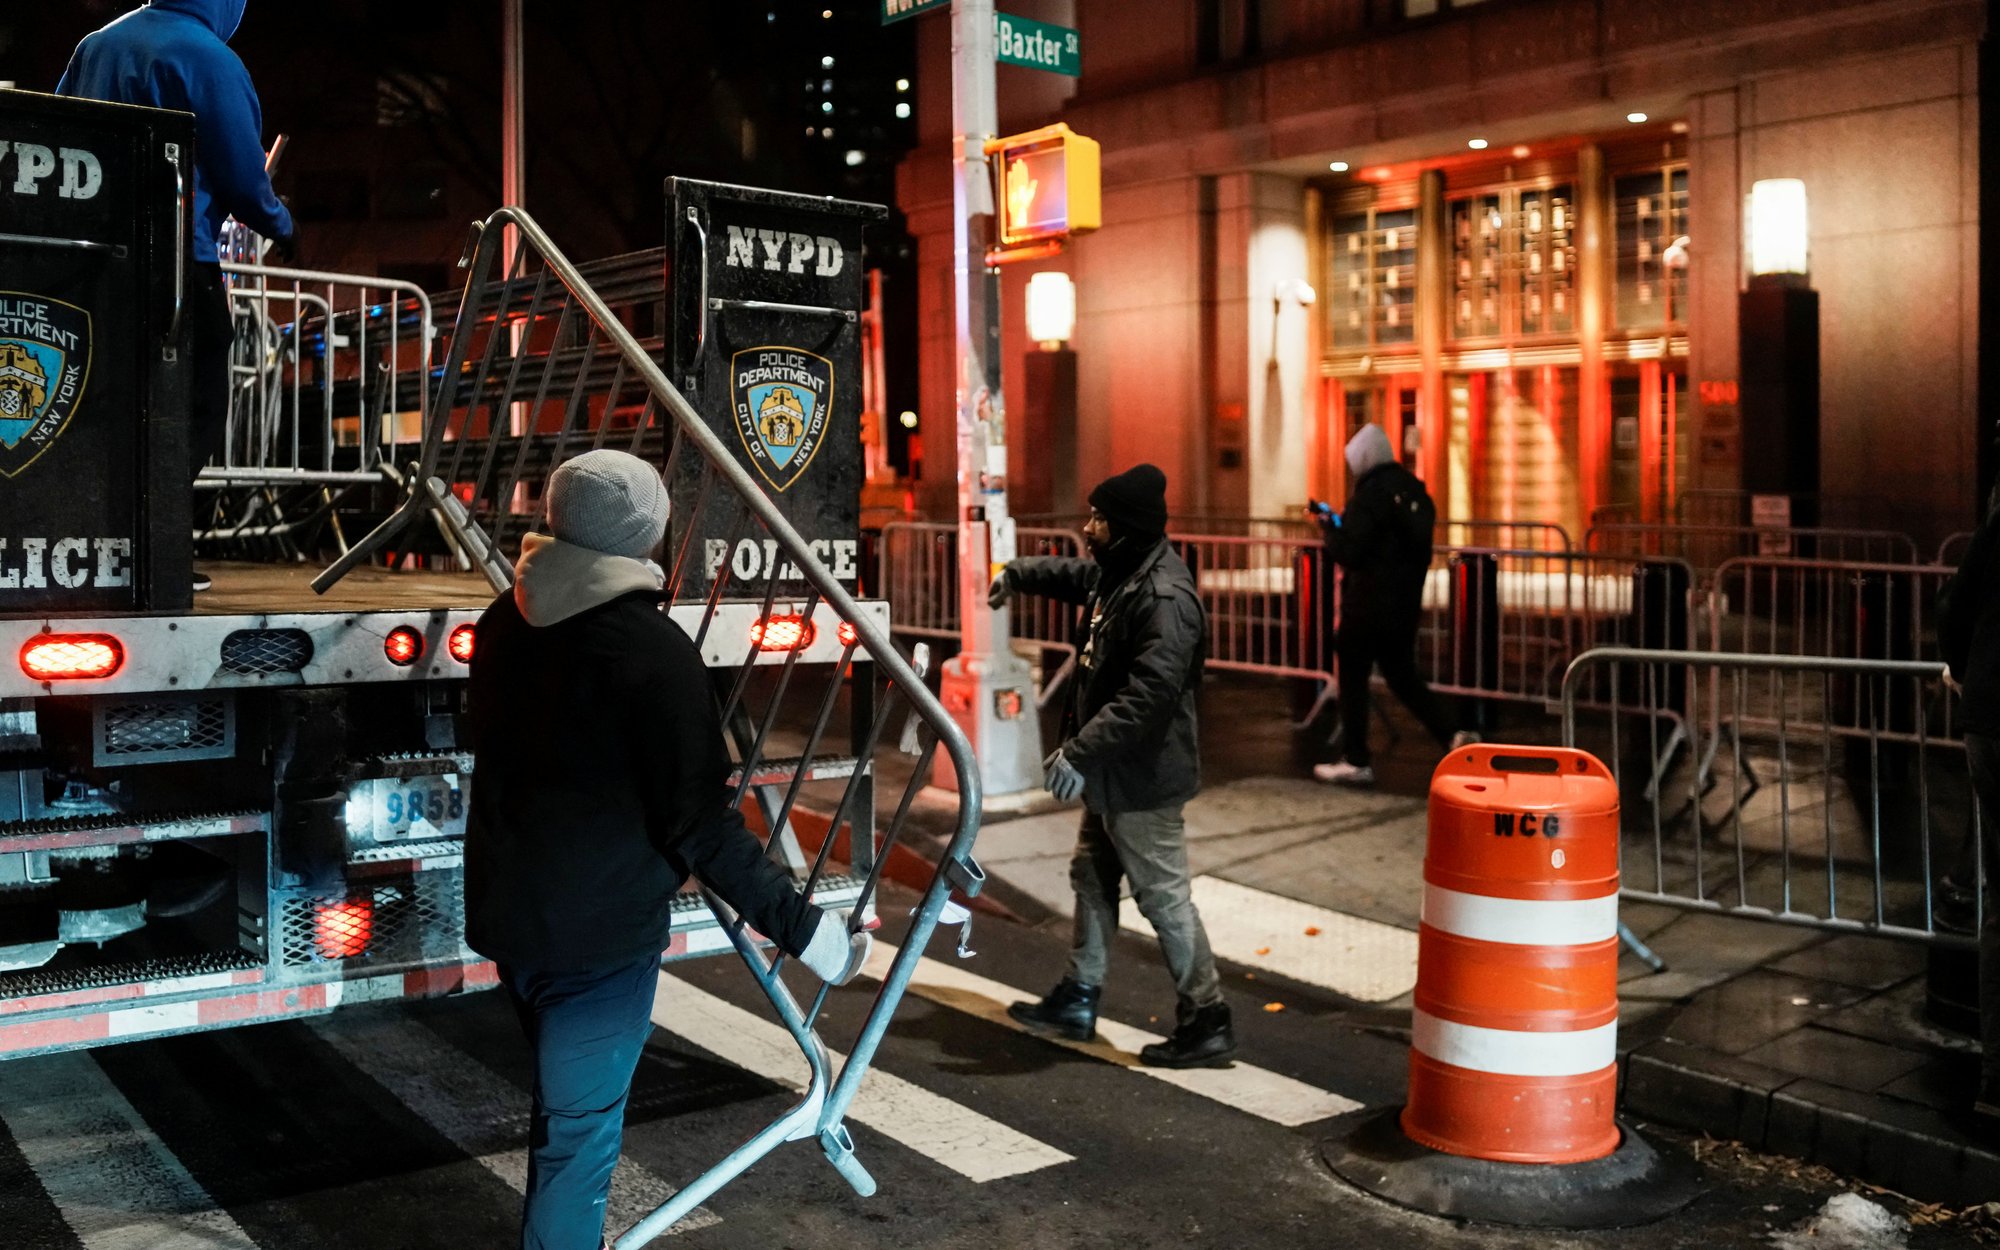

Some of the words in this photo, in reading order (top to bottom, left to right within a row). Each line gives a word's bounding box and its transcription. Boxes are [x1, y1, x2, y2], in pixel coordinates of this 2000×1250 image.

[1000, 21, 1062, 66] Baxter
[0, 141, 103, 200] PD
[726, 225, 844, 278] NYPD
[0, 299, 48, 321] LICE
[739, 367, 825, 393] DEPARTMENT
[759, 352, 806, 370] POLICE
[30, 408, 61, 446] NEW
[56, 364, 80, 404] YORK
[738, 403, 756, 436] CITY
[750, 440, 767, 459] OF
[794, 438, 814, 467] NEW
[809, 403, 826, 435] YORK
[387, 788, 463, 823] 9858
[1494, 812, 1560, 838] WCG
